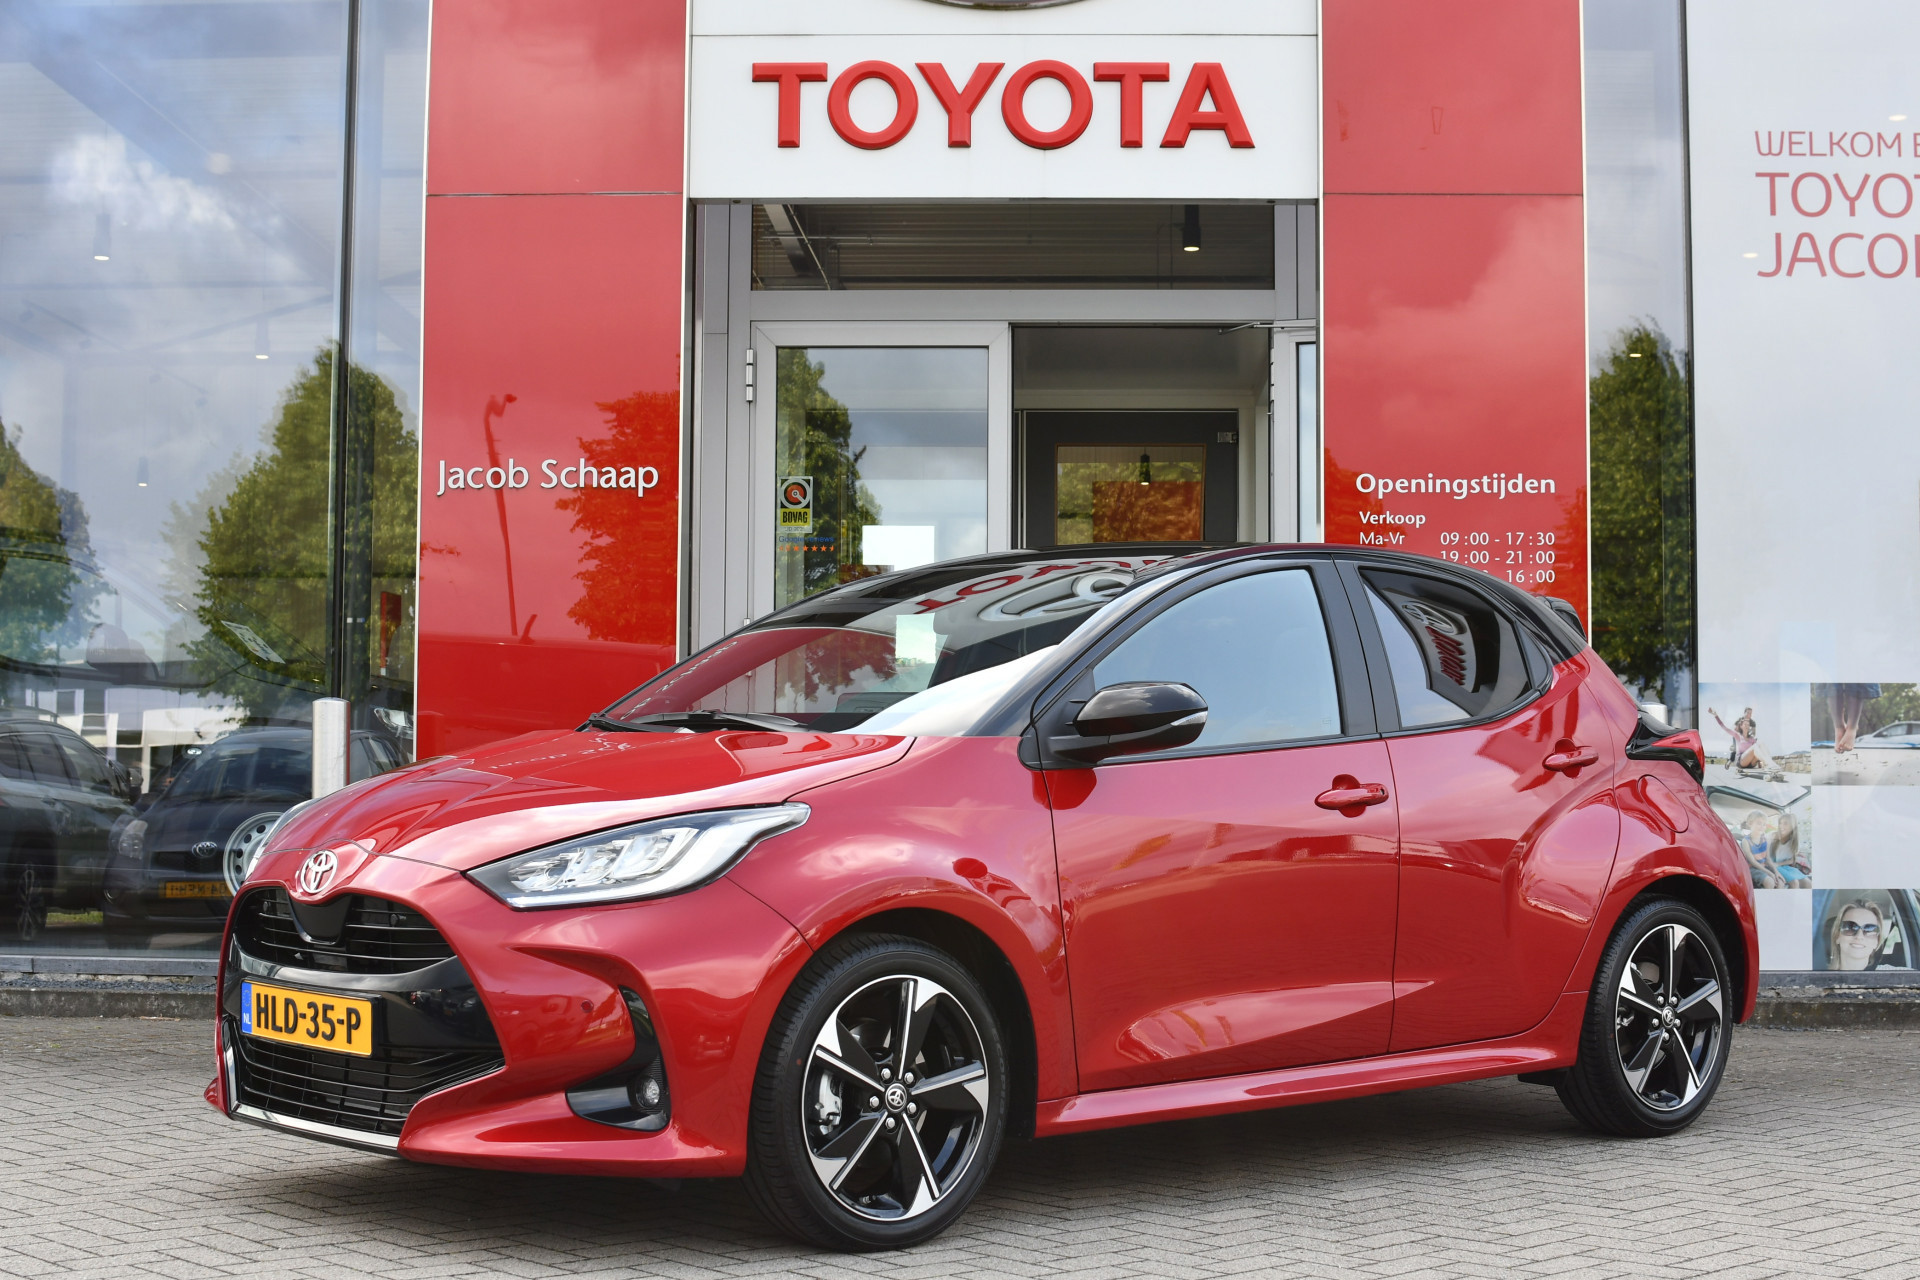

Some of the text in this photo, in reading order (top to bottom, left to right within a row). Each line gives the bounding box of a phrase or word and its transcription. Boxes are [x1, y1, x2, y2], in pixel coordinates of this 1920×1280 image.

[752, 60, 1255, 149] TOYOTA
[1755, 131, 1902, 158] WELKOM
[1755, 172, 1920, 218] TOYO
[1757, 232, 1920, 279] JACO
[437, 458, 659, 497] Jacob Schaap
[1355, 473, 1556, 500] Openingstijden
[782, 511, 808, 524] BOVAG
[1359, 511, 1426, 528] Verkoop
[1359, 531, 1406, 545] Ma-Vr
[243, 993, 361, 1045] NL HLD-35-P
